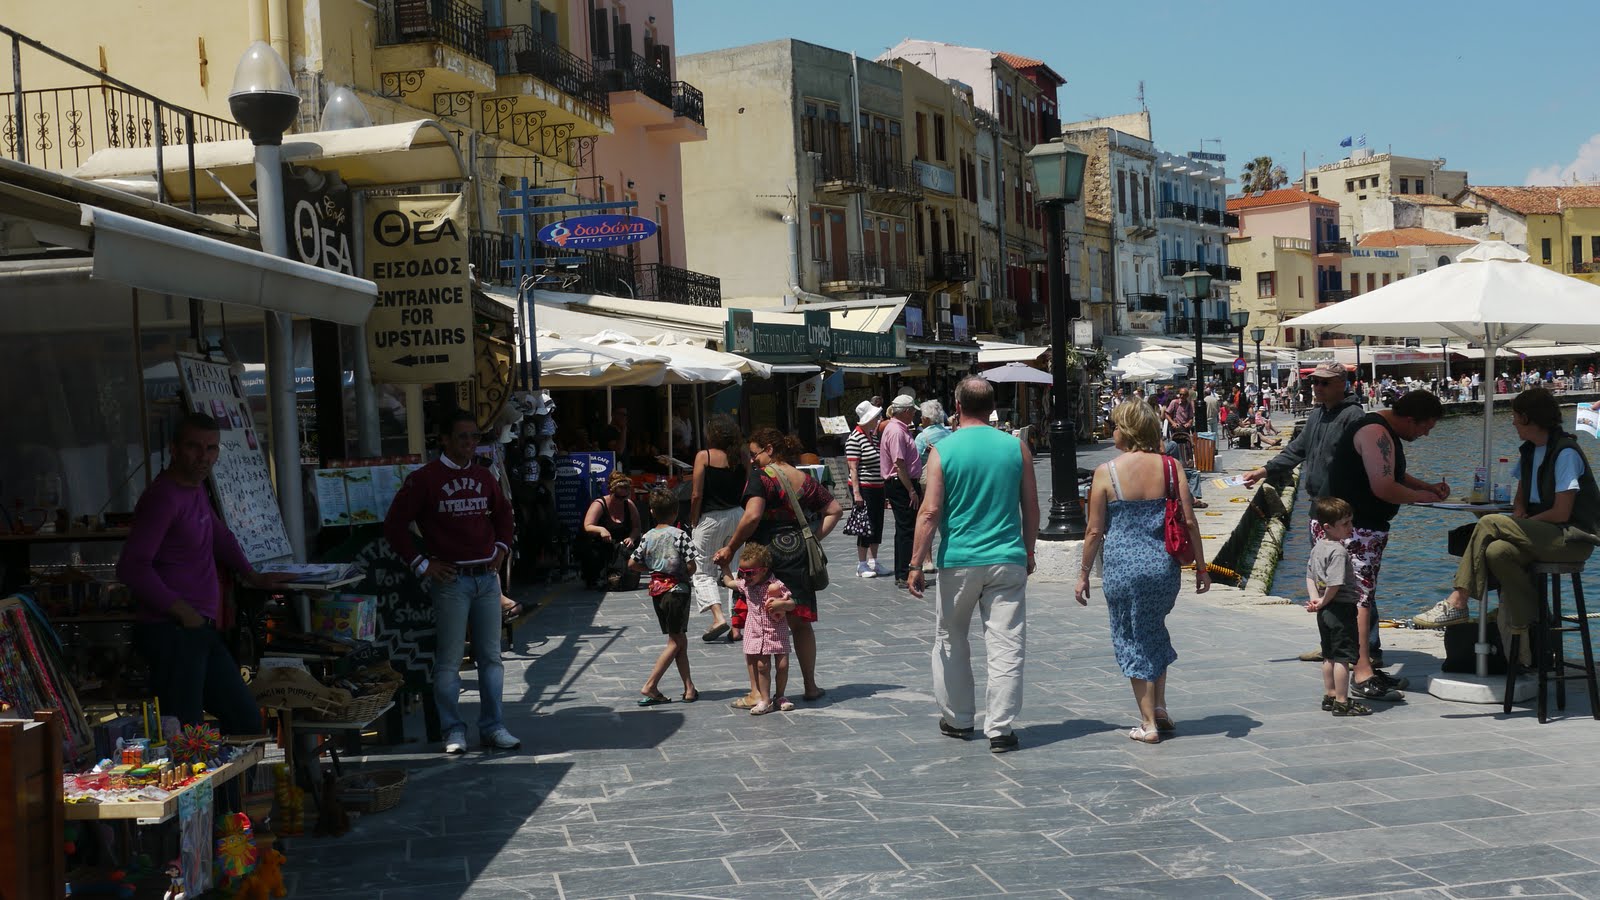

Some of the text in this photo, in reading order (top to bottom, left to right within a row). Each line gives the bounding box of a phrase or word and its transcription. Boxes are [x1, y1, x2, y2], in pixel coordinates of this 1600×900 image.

[1318, 154, 1391, 172] PORTO DEL COLOMBO
[1352, 249, 1399, 257] VILLA VENEZIA
[373, 257, 462, 279] ΕΙΣΟΔΟΣ
[373, 287, 464, 307] ENTRANCE
[401, 308, 434, 326] FOR
[375, 327, 466, 348] UPSTAIRS
[195, 362, 226, 381] HENNA
[196, 378, 232, 396] TATTOO
[572, 459, 585, 468] CAFE
[597, 456, 610, 465] CAFE
[441, 477, 483, 497] KAPPA
